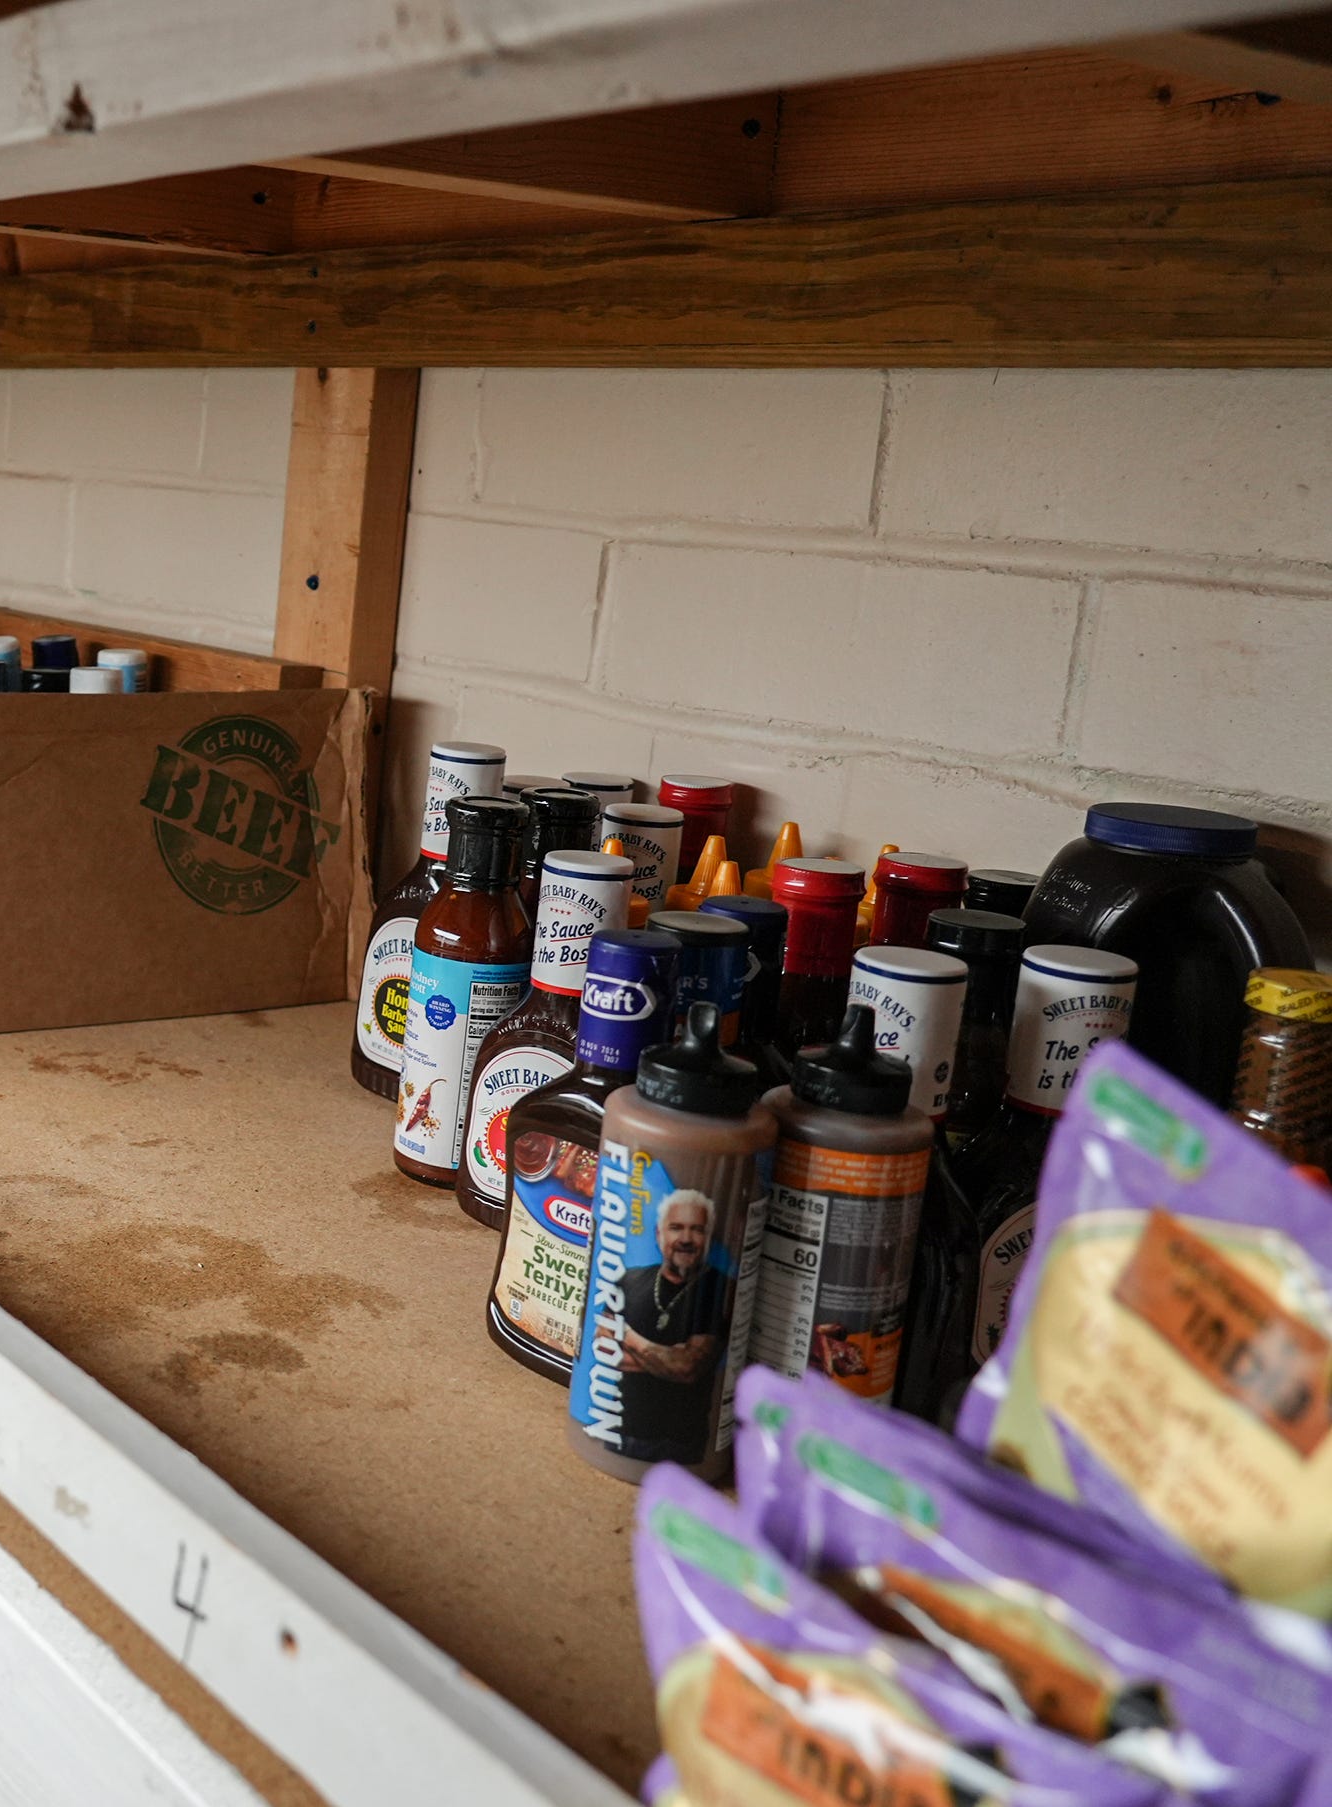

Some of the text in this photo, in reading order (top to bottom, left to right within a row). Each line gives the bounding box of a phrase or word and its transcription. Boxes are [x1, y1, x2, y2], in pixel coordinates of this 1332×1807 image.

[202, 729, 306, 799] GENUINELY
[447, 773, 472, 796] RAY'S
[139, 744, 341, 879] BEEF
[429, 796, 446, 811] Sau
[643, 839, 667, 862] RAY'S
[178, 851, 266, 899] BETTER
[634, 864, 658, 879] uce
[552, 884, 579, 900] BABY
[578, 893, 607, 919] RAY'S
[550, 920, 595, 938] Sauce
[373, 938, 413, 966] SWEET BA
[539, 946, 556, 964] the
[559, 945, 589, 963] Bos
[411, 969, 439, 991] odney
[472, 985, 502, 997] Nutrition
[386, 987, 409, 1011] Hon
[470, 1006, 486, 1014] Serving
[584, 982, 634, 1013] Kraft
[855, 980, 916, 1029] BABY RAY'S
[1042, 996, 1086, 1022] SWEET
[1089, 995, 1121, 1010] BABY
[381, 1003, 407, 1025] Barbe
[386, 1020, 406, 1036] Sau
[468, 1025, 487, 1035] Calori
[1045, 1040, 1080, 1061] The
[483, 1068, 554, 1096] SWEET BAB
[1037, 1069, 1055, 1090] is
[629, 1151, 652, 1186] Guy
[778, 1189, 824, 1215] Facts
[555, 1203, 592, 1230] Kraft
[793, 1248, 818, 1268] 60
[994, 1228, 1034, 1265] SWE
[532, 1244, 586, 1281] Swee
[523, 1258, 586, 1302] Teriya
[525, 1284, 569, 1312] BARBECUE
[171, 1538, 209, 1665] 4
